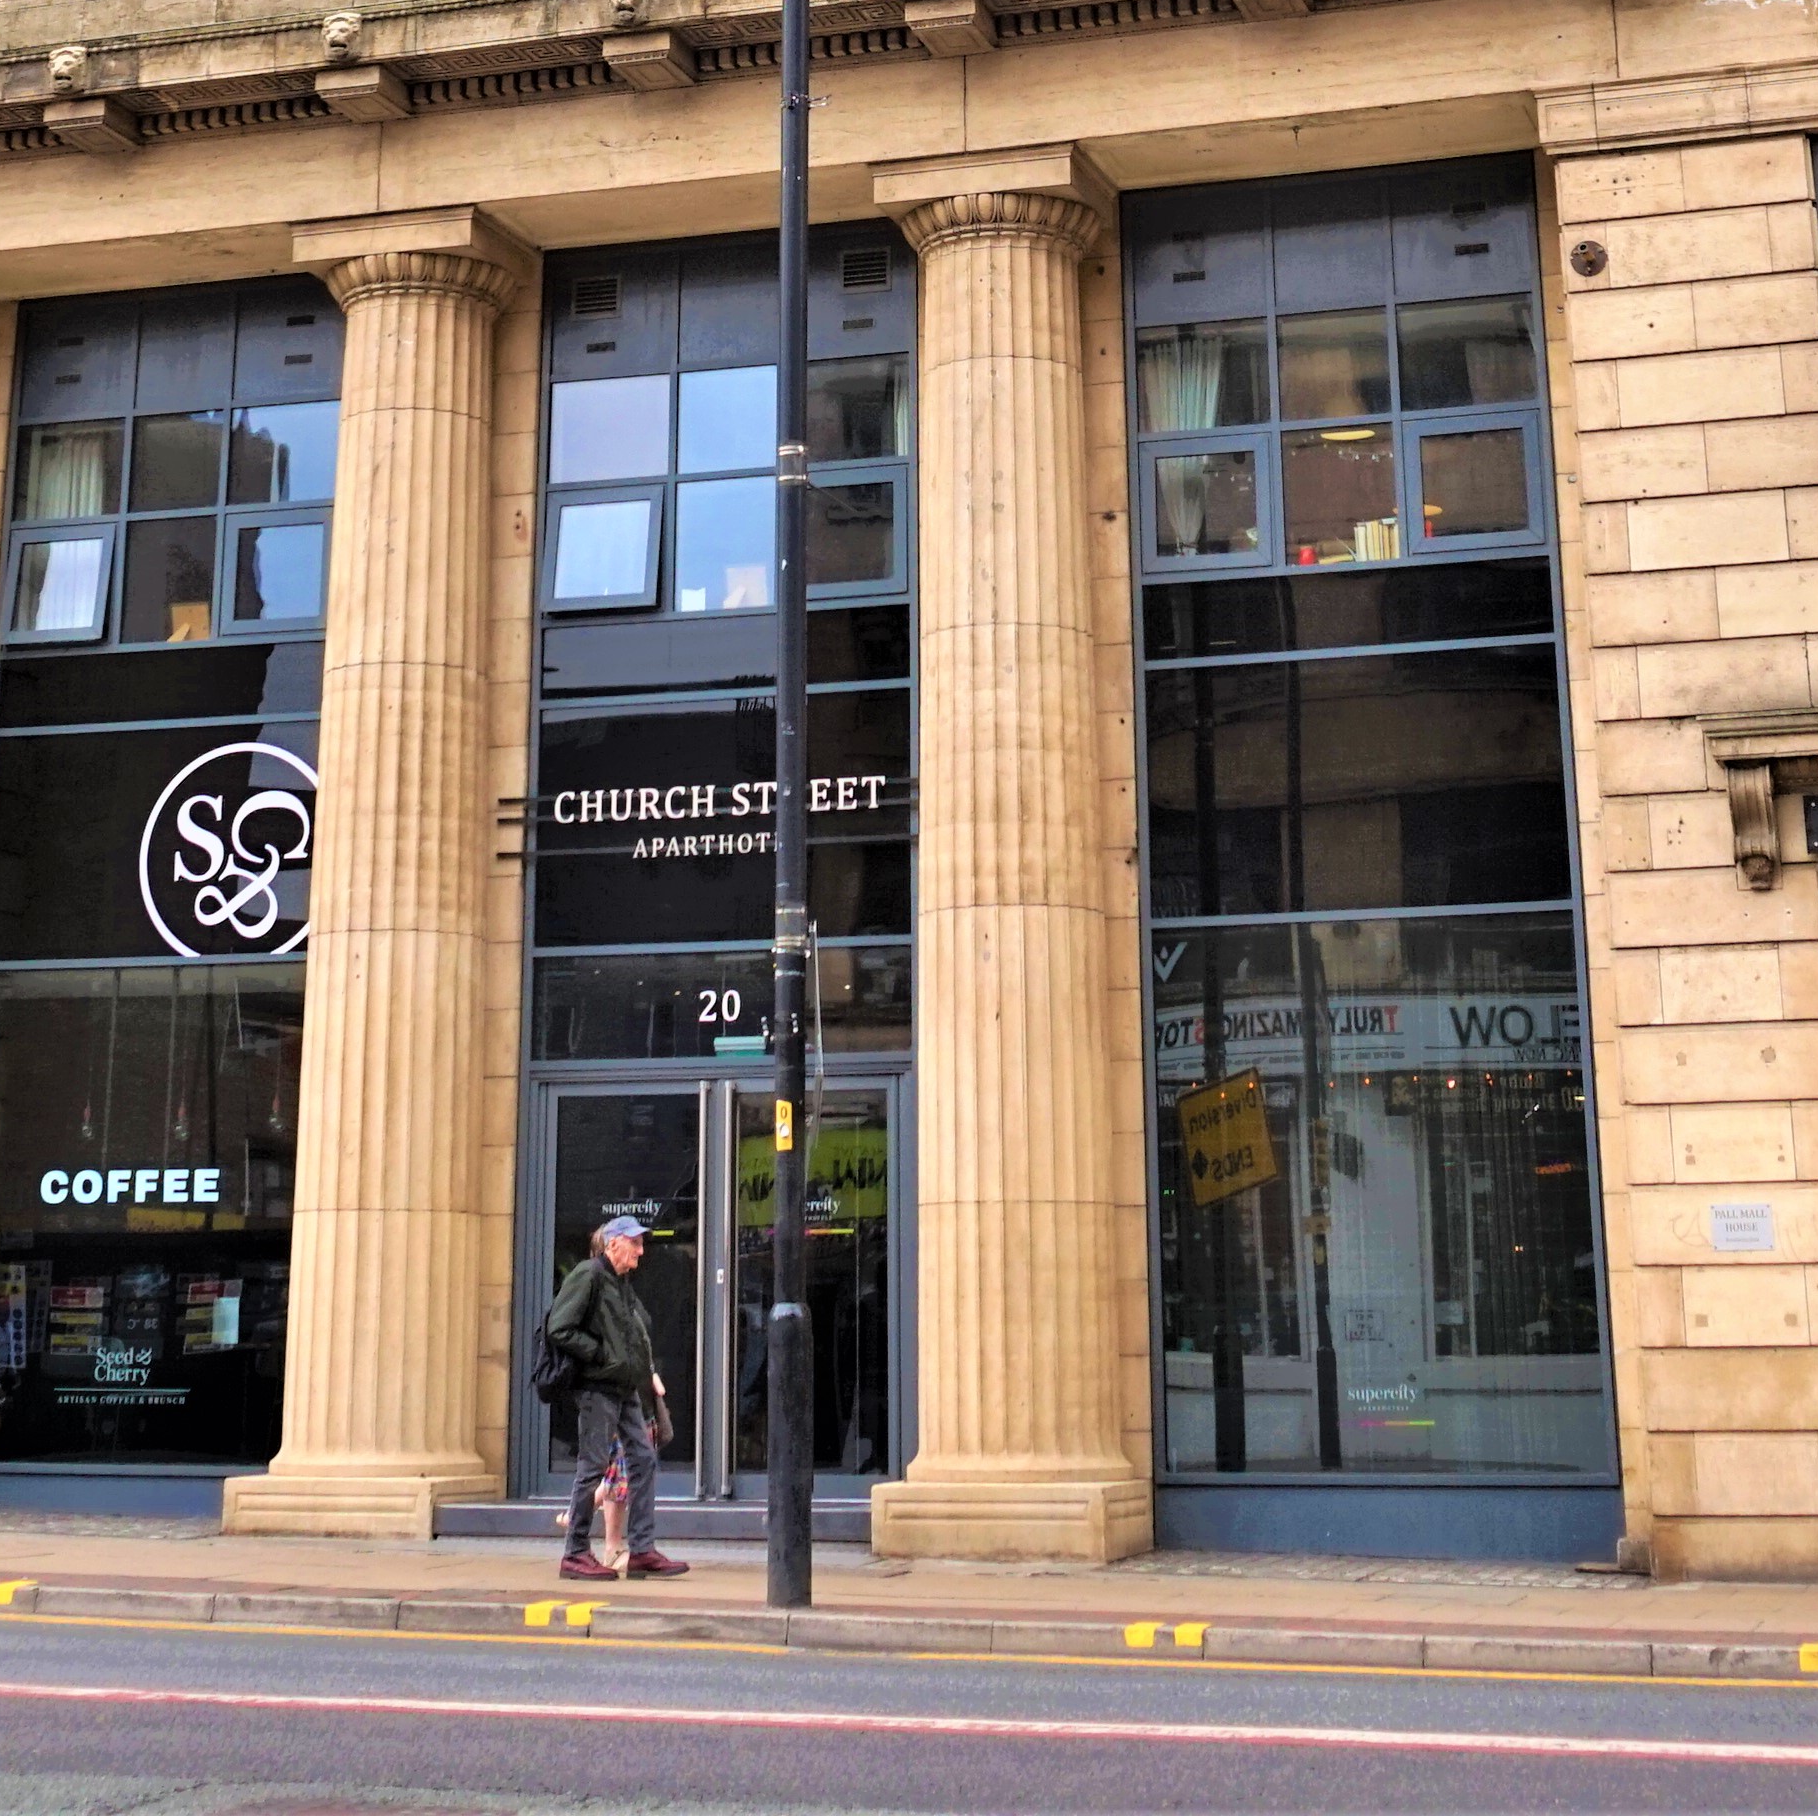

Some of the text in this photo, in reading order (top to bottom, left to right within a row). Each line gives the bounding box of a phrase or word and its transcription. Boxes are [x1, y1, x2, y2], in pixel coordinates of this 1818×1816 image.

[554, 776, 886, 824] CHURCH STEET
[633, 832, 781, 859] APARTHOT
[699, 989, 741, 1022] 20
[40, 1168, 221, 1204] COFFEE
[1715, 1208, 1768, 1220] PALL MALL
[1726, 1221, 1759, 1233] HOUSE
[95, 1347, 135, 1366] Seed
[93, 1363, 151, 1386] Cherry
